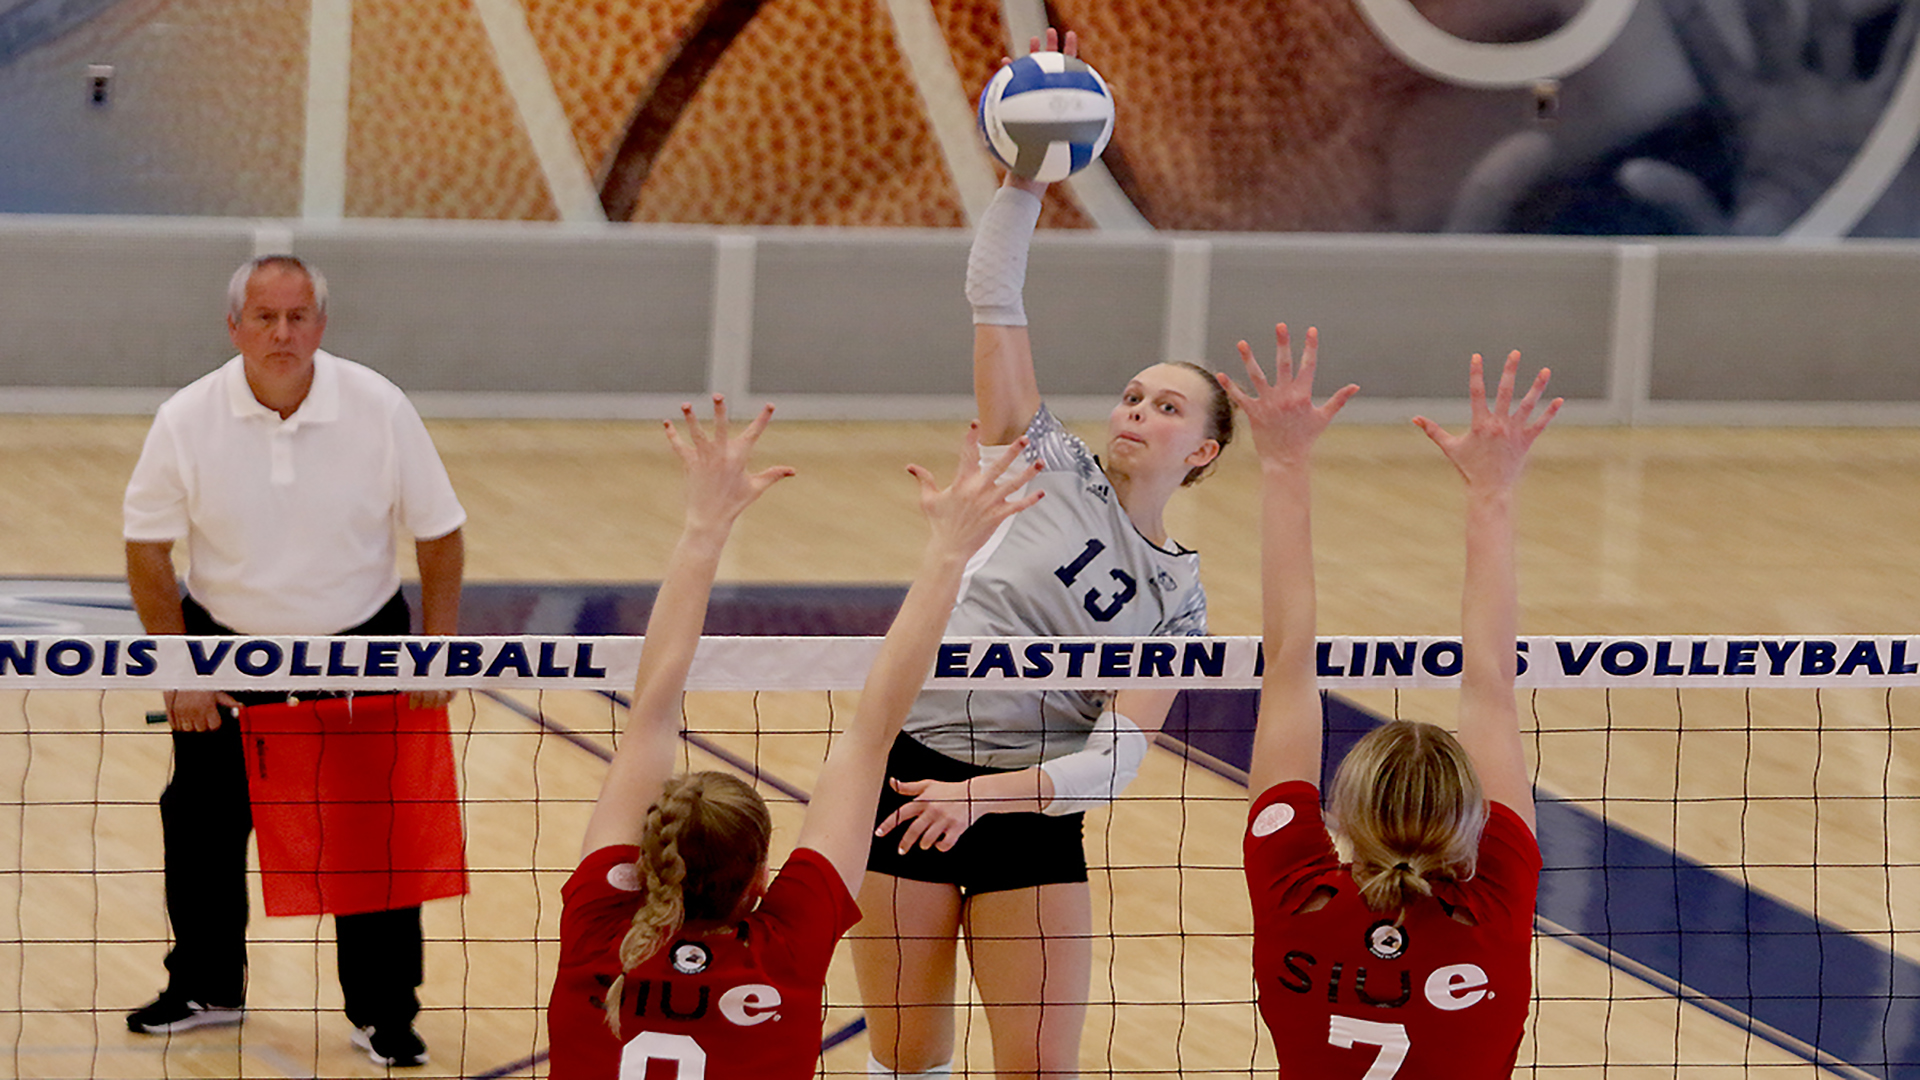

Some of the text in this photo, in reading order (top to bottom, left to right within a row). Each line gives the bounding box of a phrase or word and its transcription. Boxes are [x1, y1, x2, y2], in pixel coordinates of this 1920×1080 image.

[1054, 538, 1137, 622] 13
[0, 640, 606, 678] NOIS VOLLEYBALL
[934, 640, 1919, 678] EASTERN ILINO VOLLEYBAL
[1328, 1014, 1411, 1080] 7
